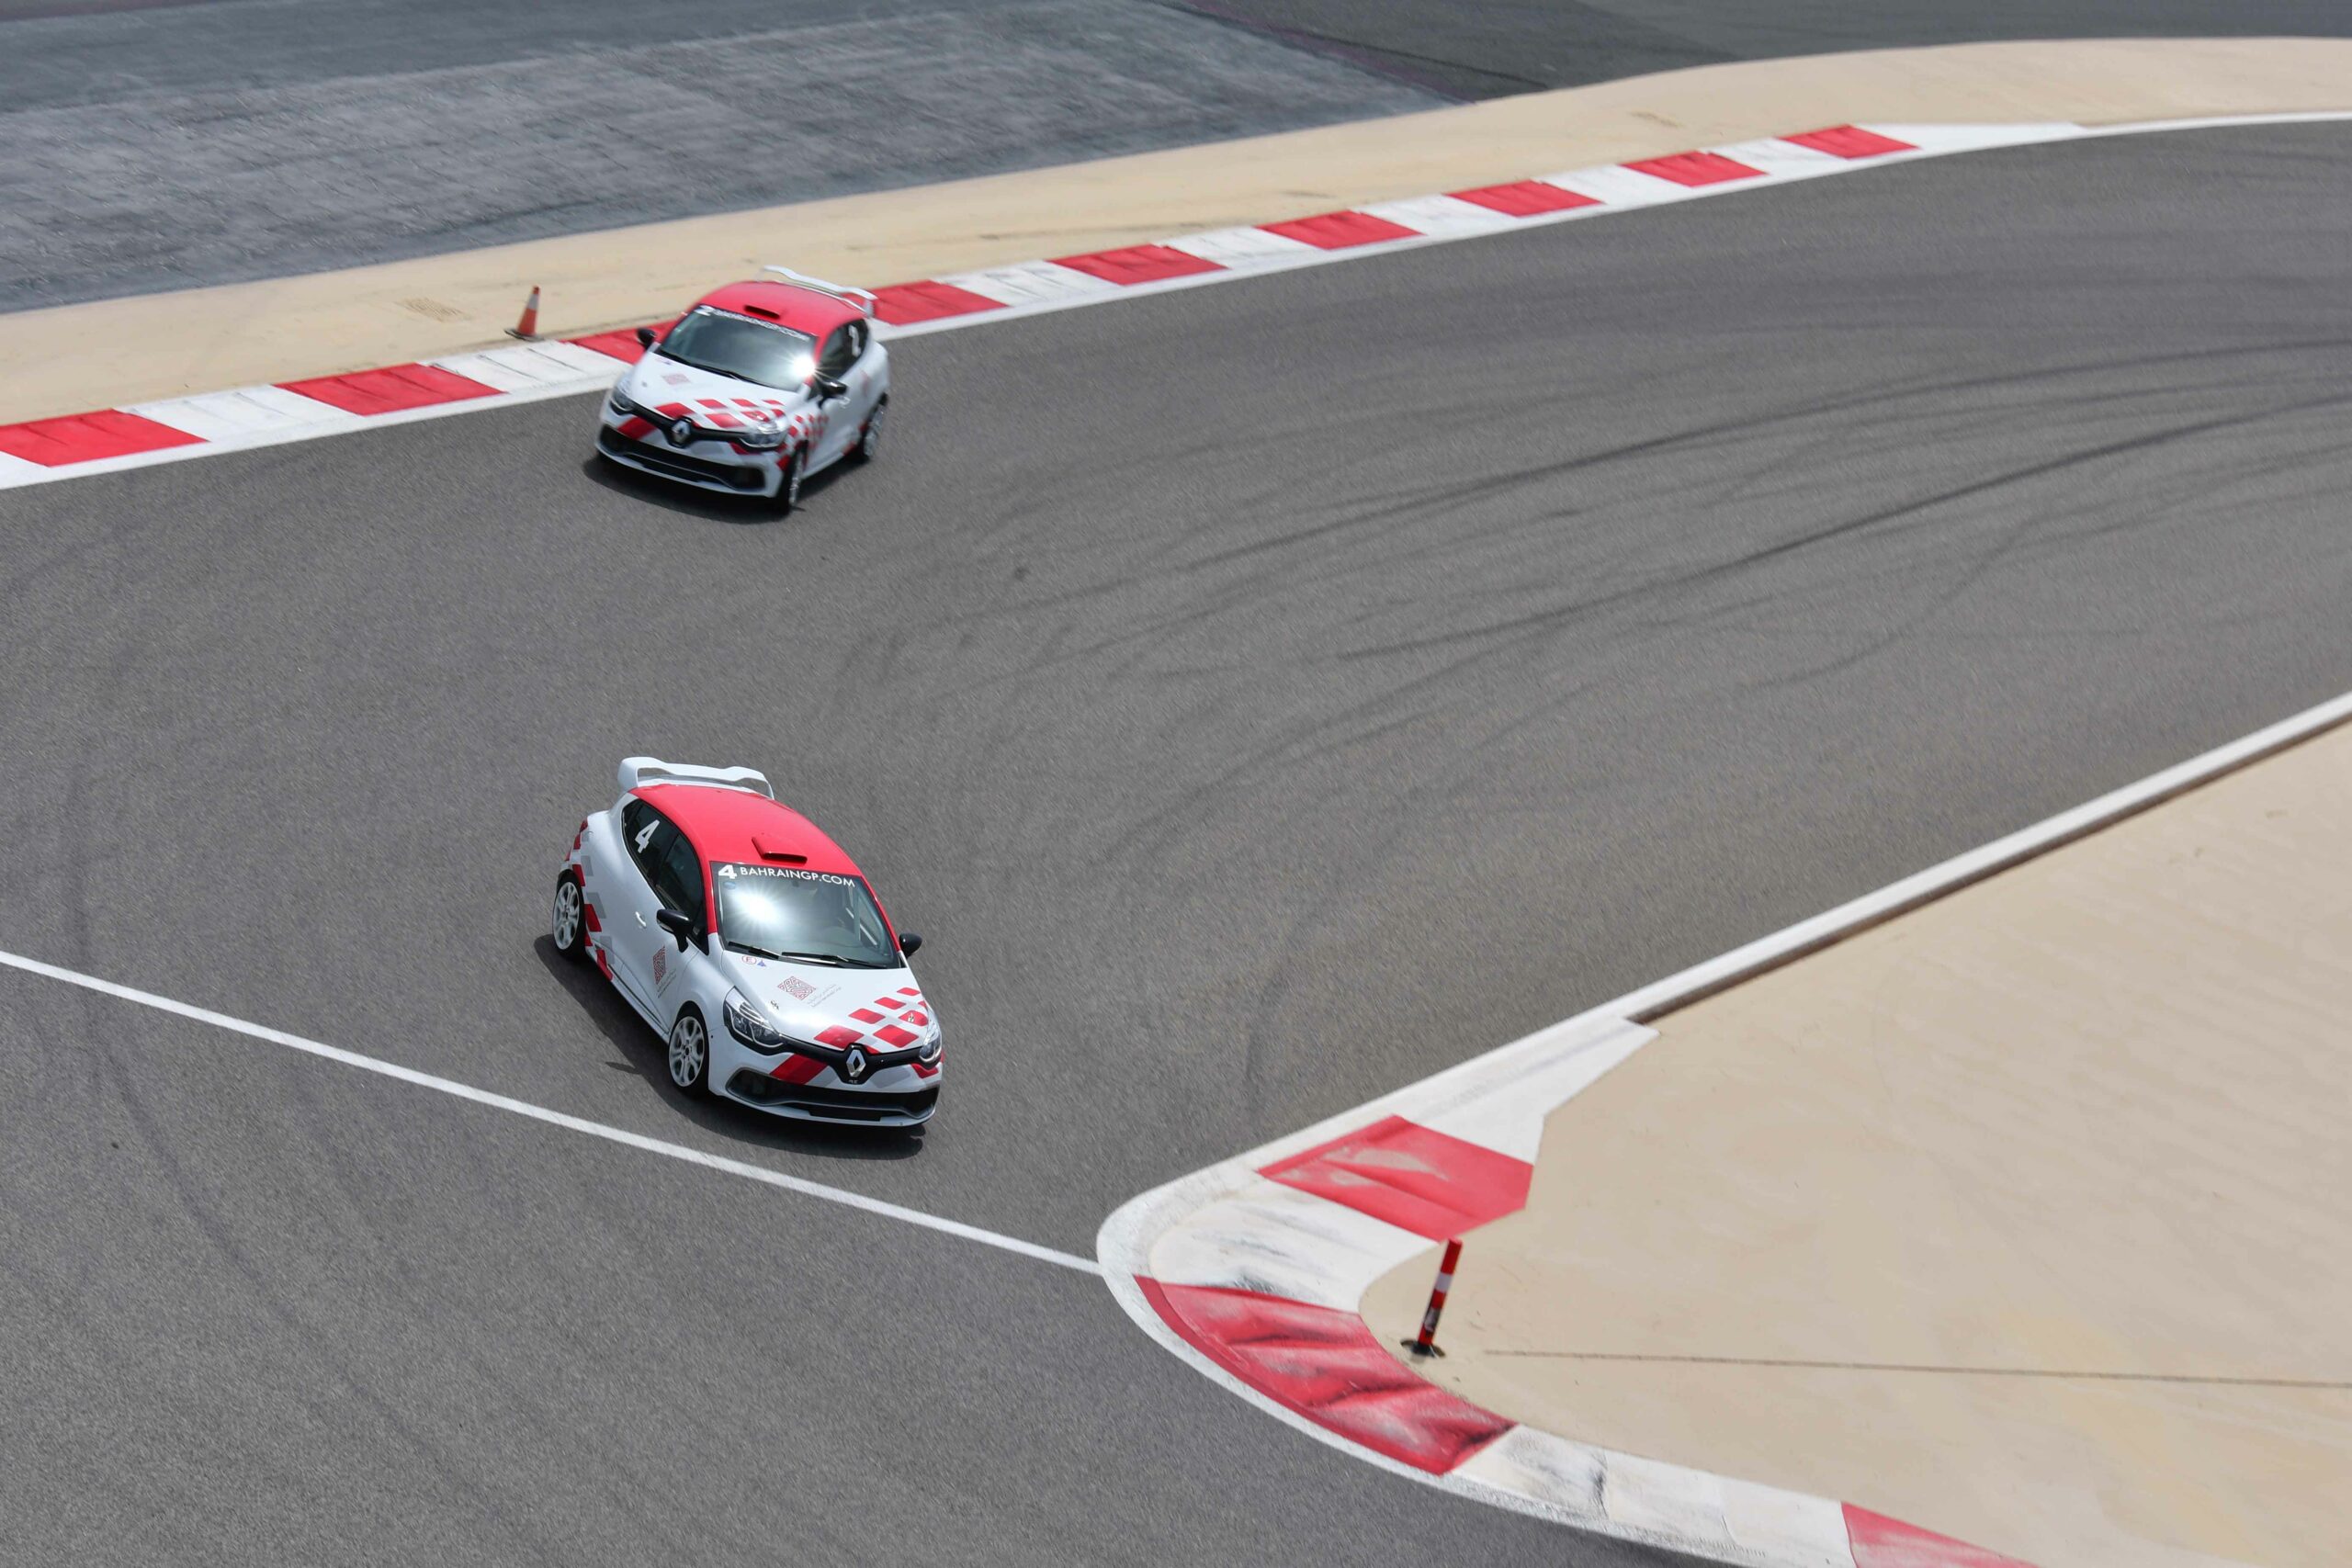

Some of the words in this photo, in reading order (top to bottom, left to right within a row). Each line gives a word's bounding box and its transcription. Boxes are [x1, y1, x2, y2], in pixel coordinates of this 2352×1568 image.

[635, 819, 660, 853] 4
[718, 864, 737, 879] 4
[740, 866, 855, 887] BAHRAINGP.COM
